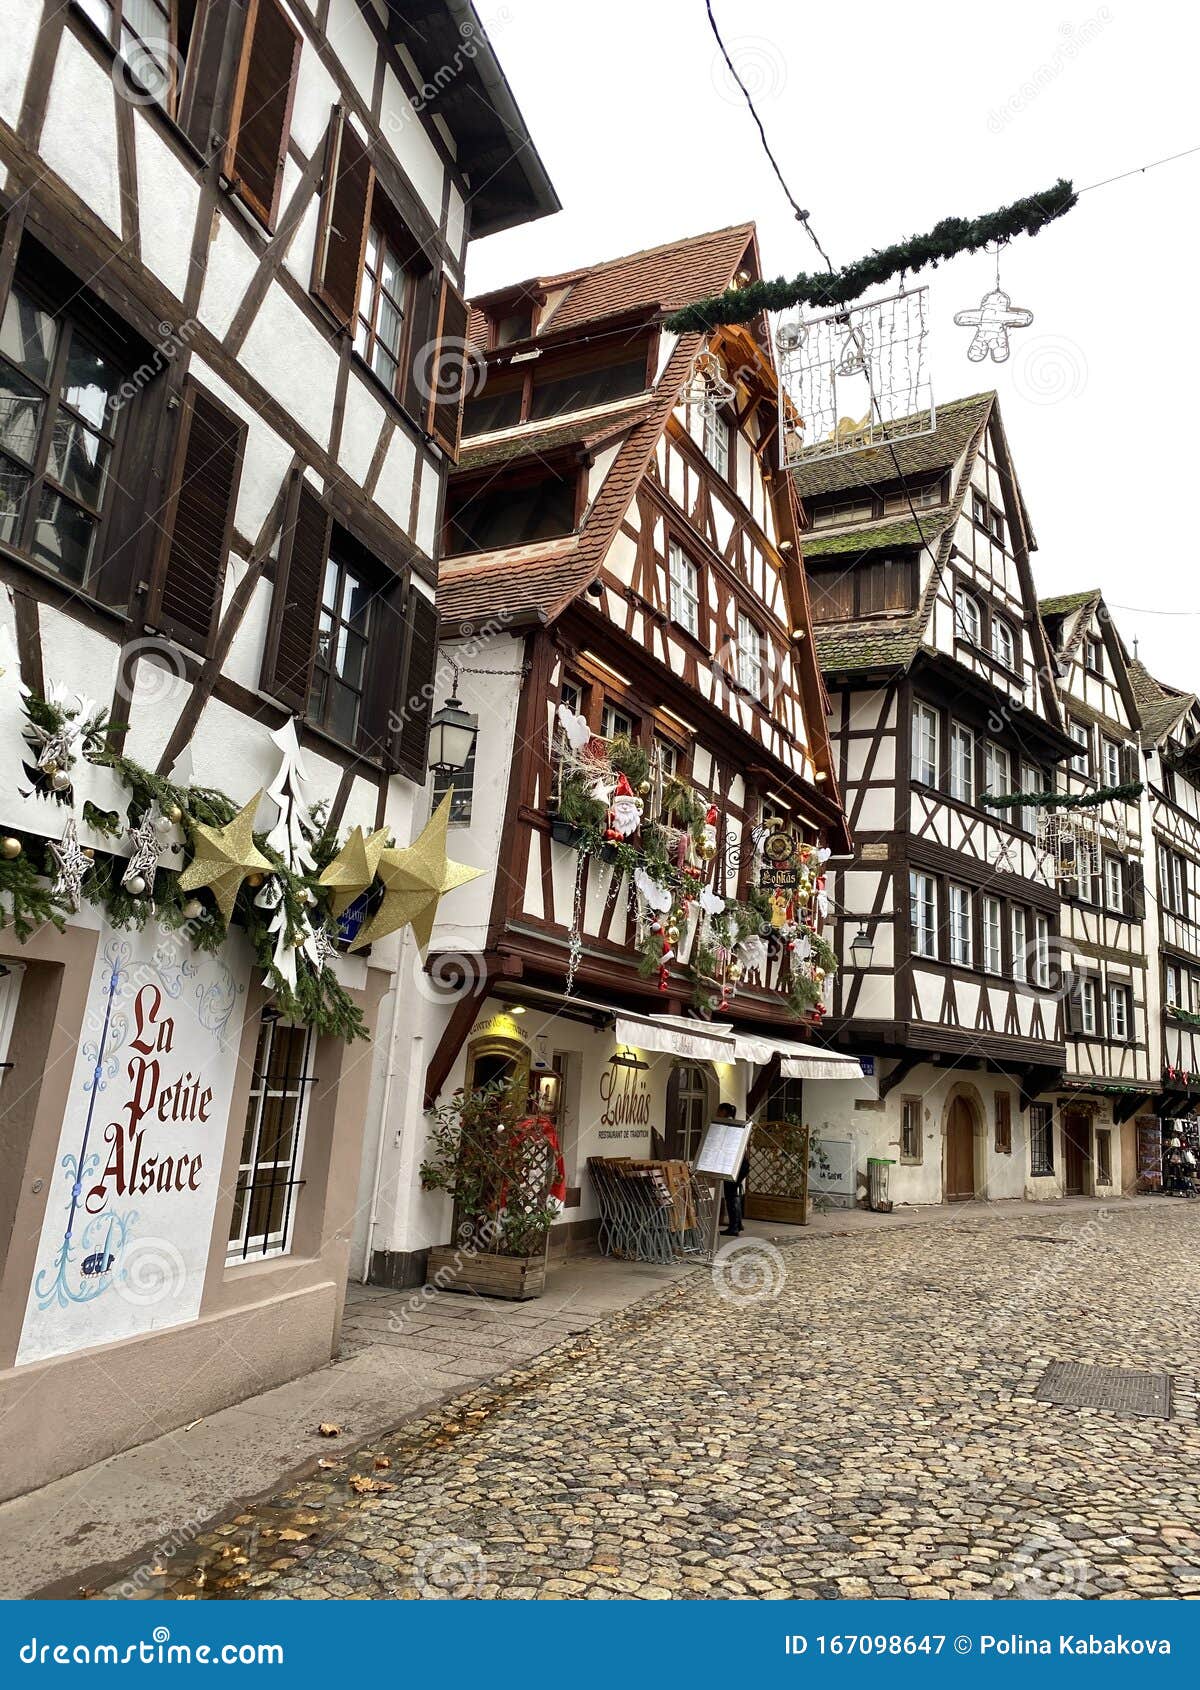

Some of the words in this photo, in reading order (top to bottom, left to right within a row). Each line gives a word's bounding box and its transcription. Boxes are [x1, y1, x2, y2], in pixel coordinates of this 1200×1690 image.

[129, 984, 175, 1055] La
[122, 1056, 213, 1141] Petite
[600, 1063, 651, 1126] Lohkäs
[85, 1122, 203, 1214] Alsace
[630, 1130, 648, 1138] TRADITION
